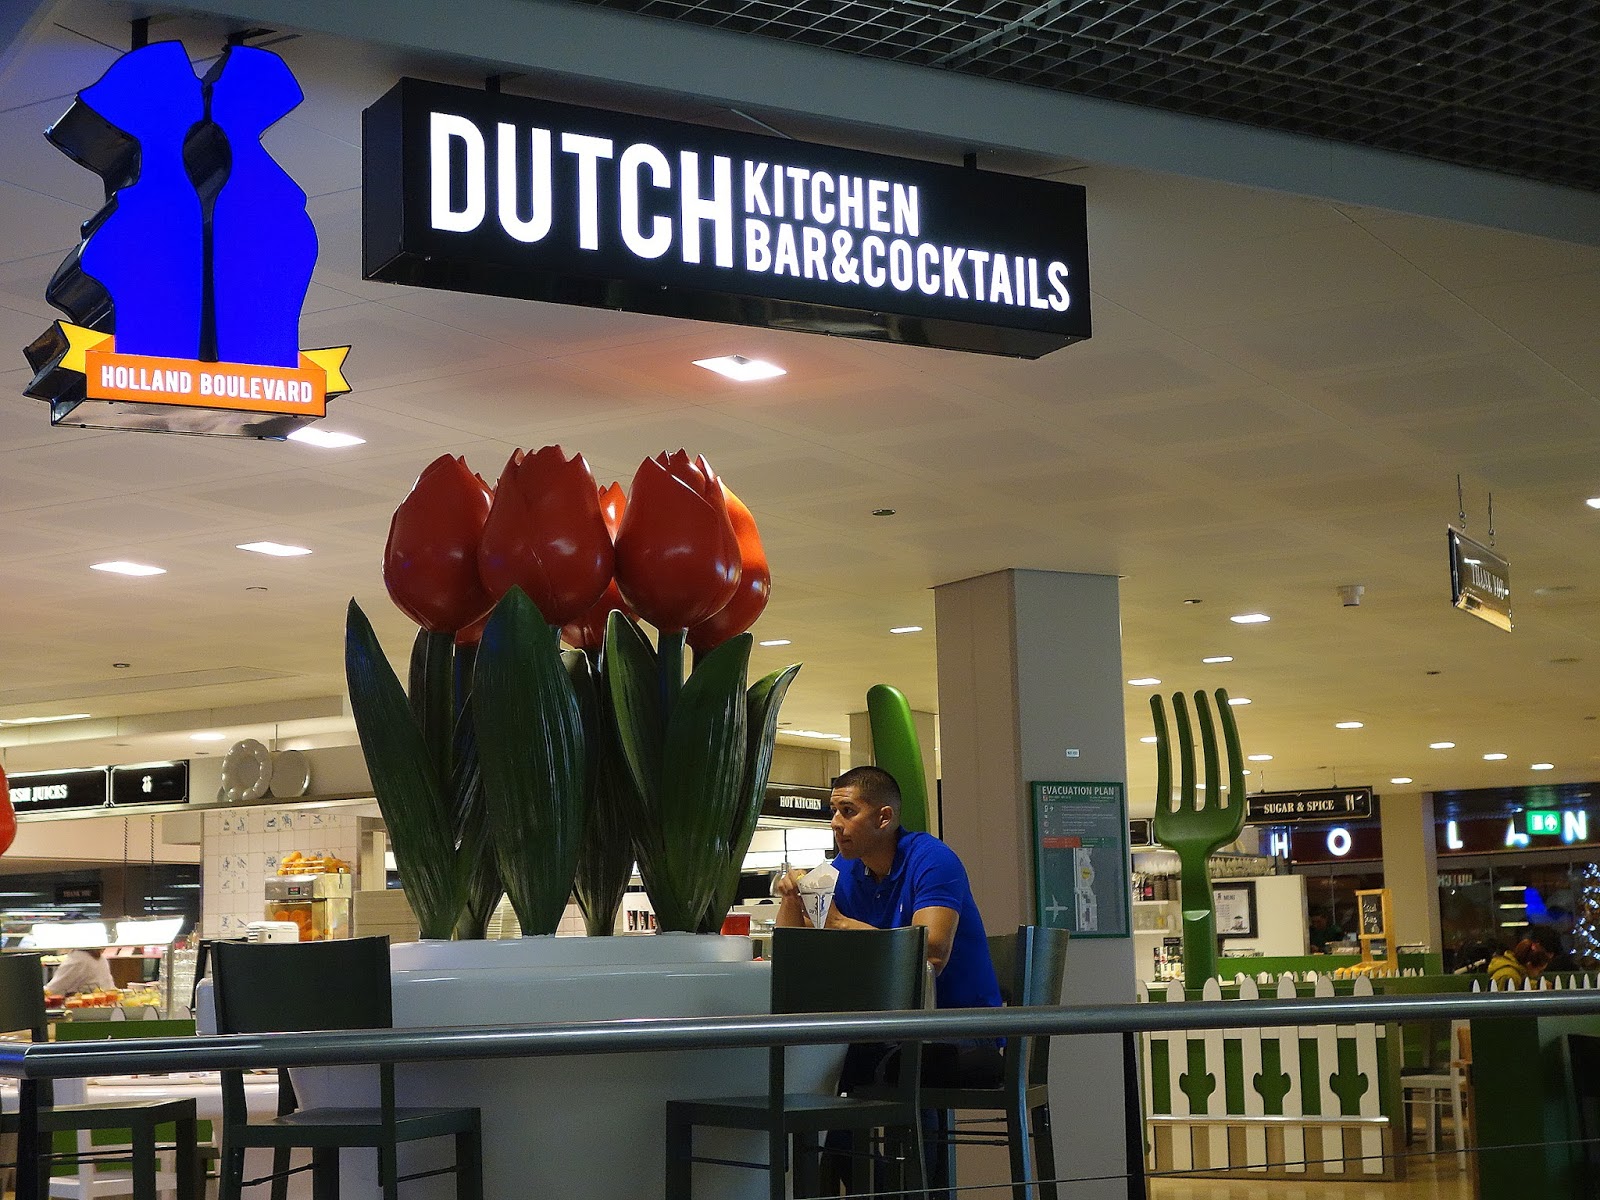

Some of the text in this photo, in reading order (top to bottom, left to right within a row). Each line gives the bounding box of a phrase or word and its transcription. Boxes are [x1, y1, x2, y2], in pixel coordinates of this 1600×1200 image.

[430, 111, 733, 268] DUTCH
[744, 160, 919, 237] KITCHEN
[745, 218, 1070, 312] BAR&COCKTAILS
[101, 365, 313, 403] HOLLAND BOULEVARD
[32, 784, 68, 802] JUICES
[780, 795, 821, 810] HOT KITCHEN
[1042, 786, 1114, 795] EVACUATION PLAN
[1263, 800, 1335, 814] SUGAR & SPICE
